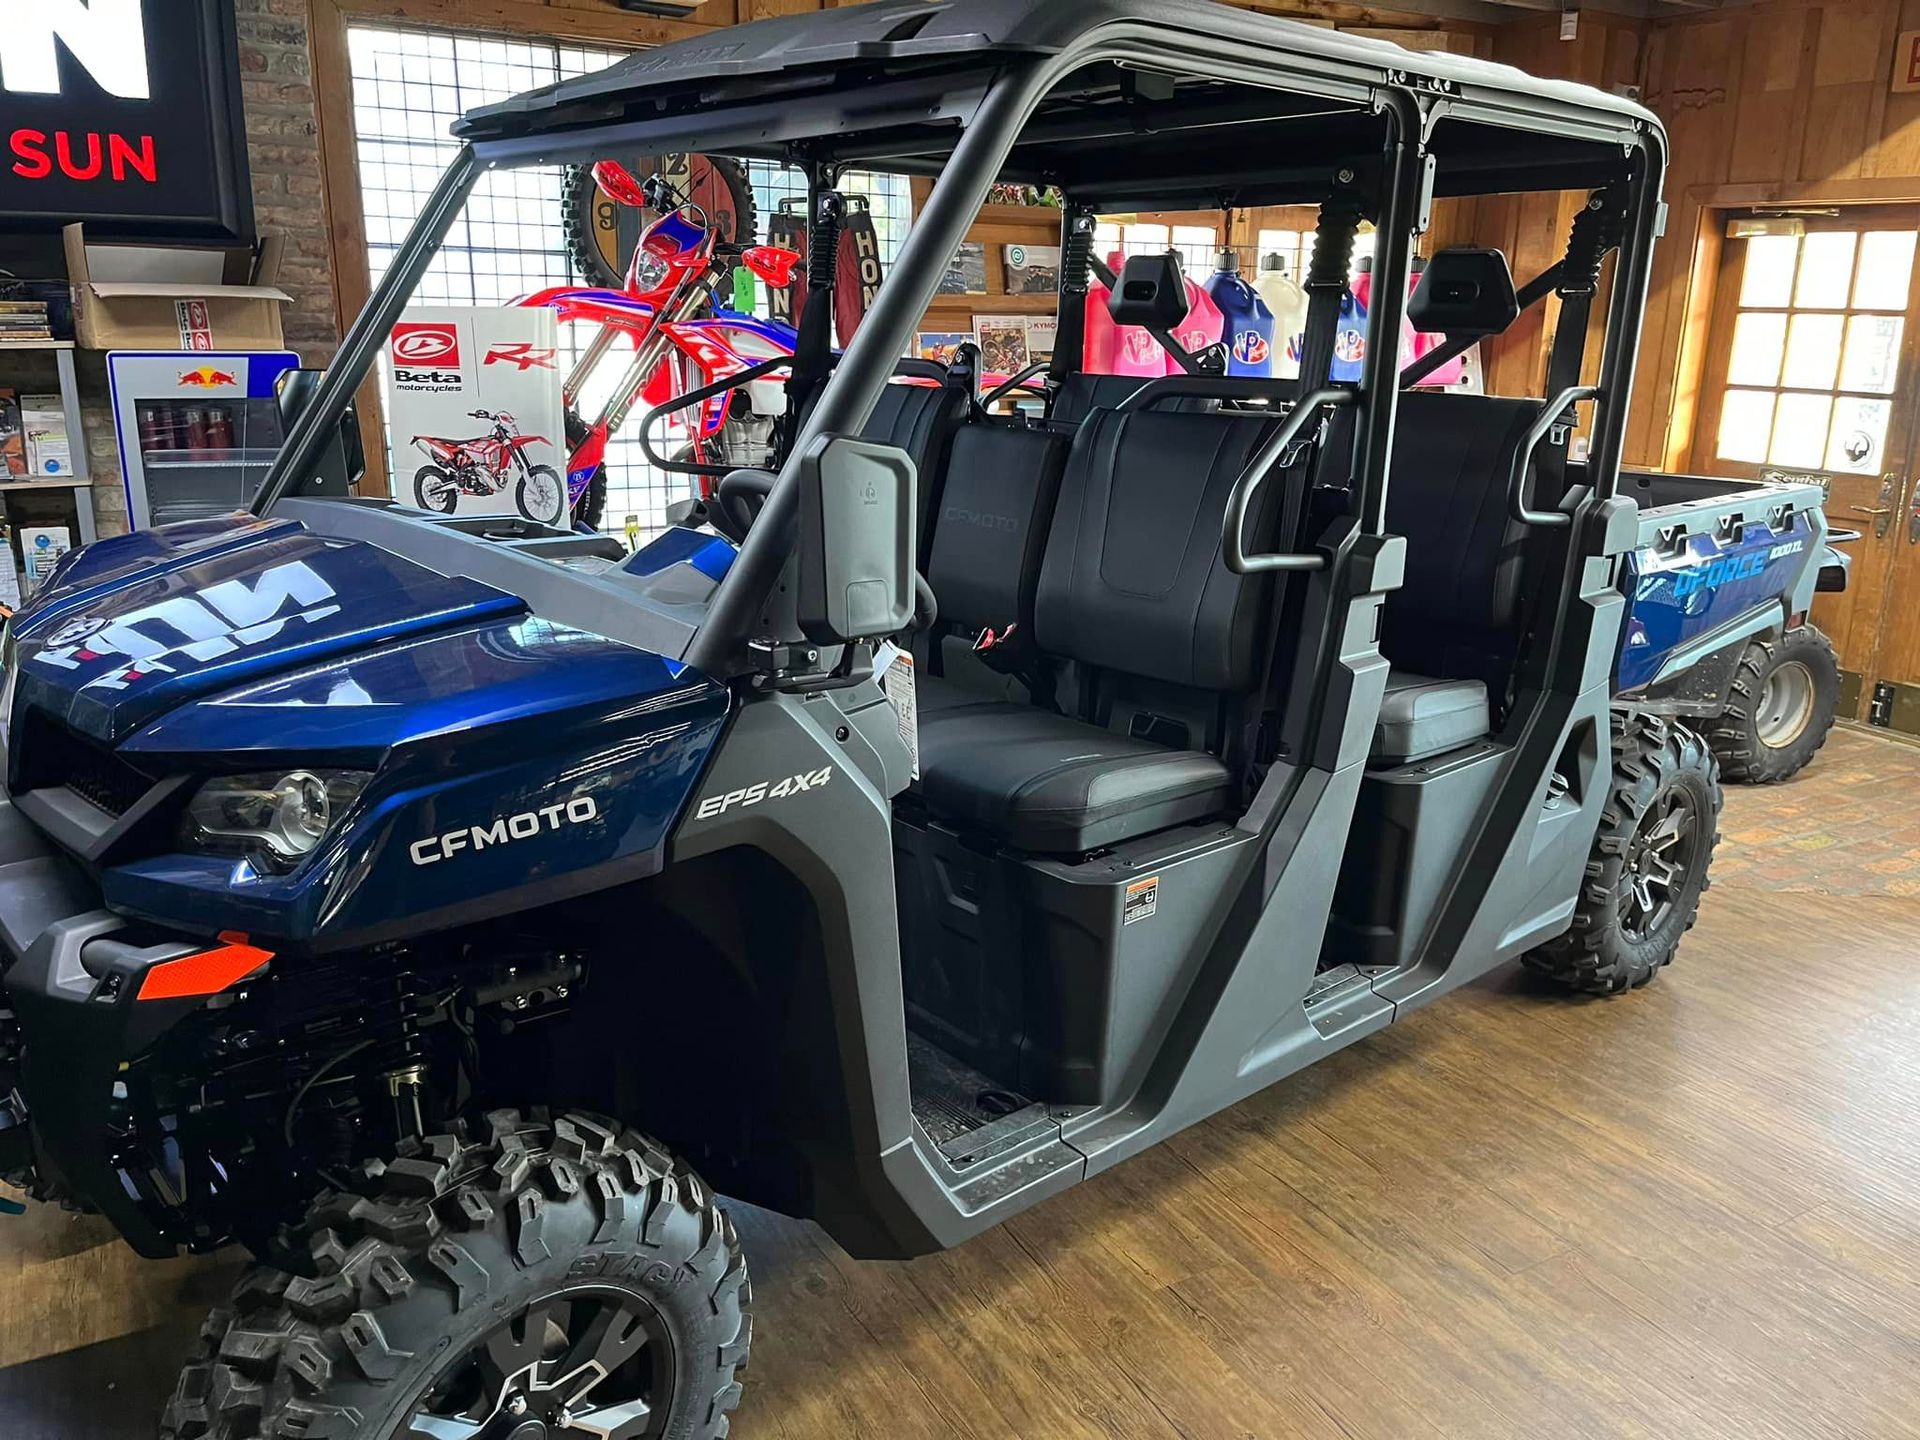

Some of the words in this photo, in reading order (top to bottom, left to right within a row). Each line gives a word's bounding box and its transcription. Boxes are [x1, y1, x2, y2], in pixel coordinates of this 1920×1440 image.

[9, 128, 157, 182] SUN
[598, 202, 616, 231] 9
[1236, 330, 1259, 362] VP
[1289, 332, 1304, 362] V
[395, 370, 462, 383] Beta
[396, 384, 462, 393] motorcycles
[945, 507, 1018, 533] CFMOTO
[695, 780, 769, 821] EPS
[771, 766, 832, 797] 4X4
[410, 797, 595, 866] CFMOTO
